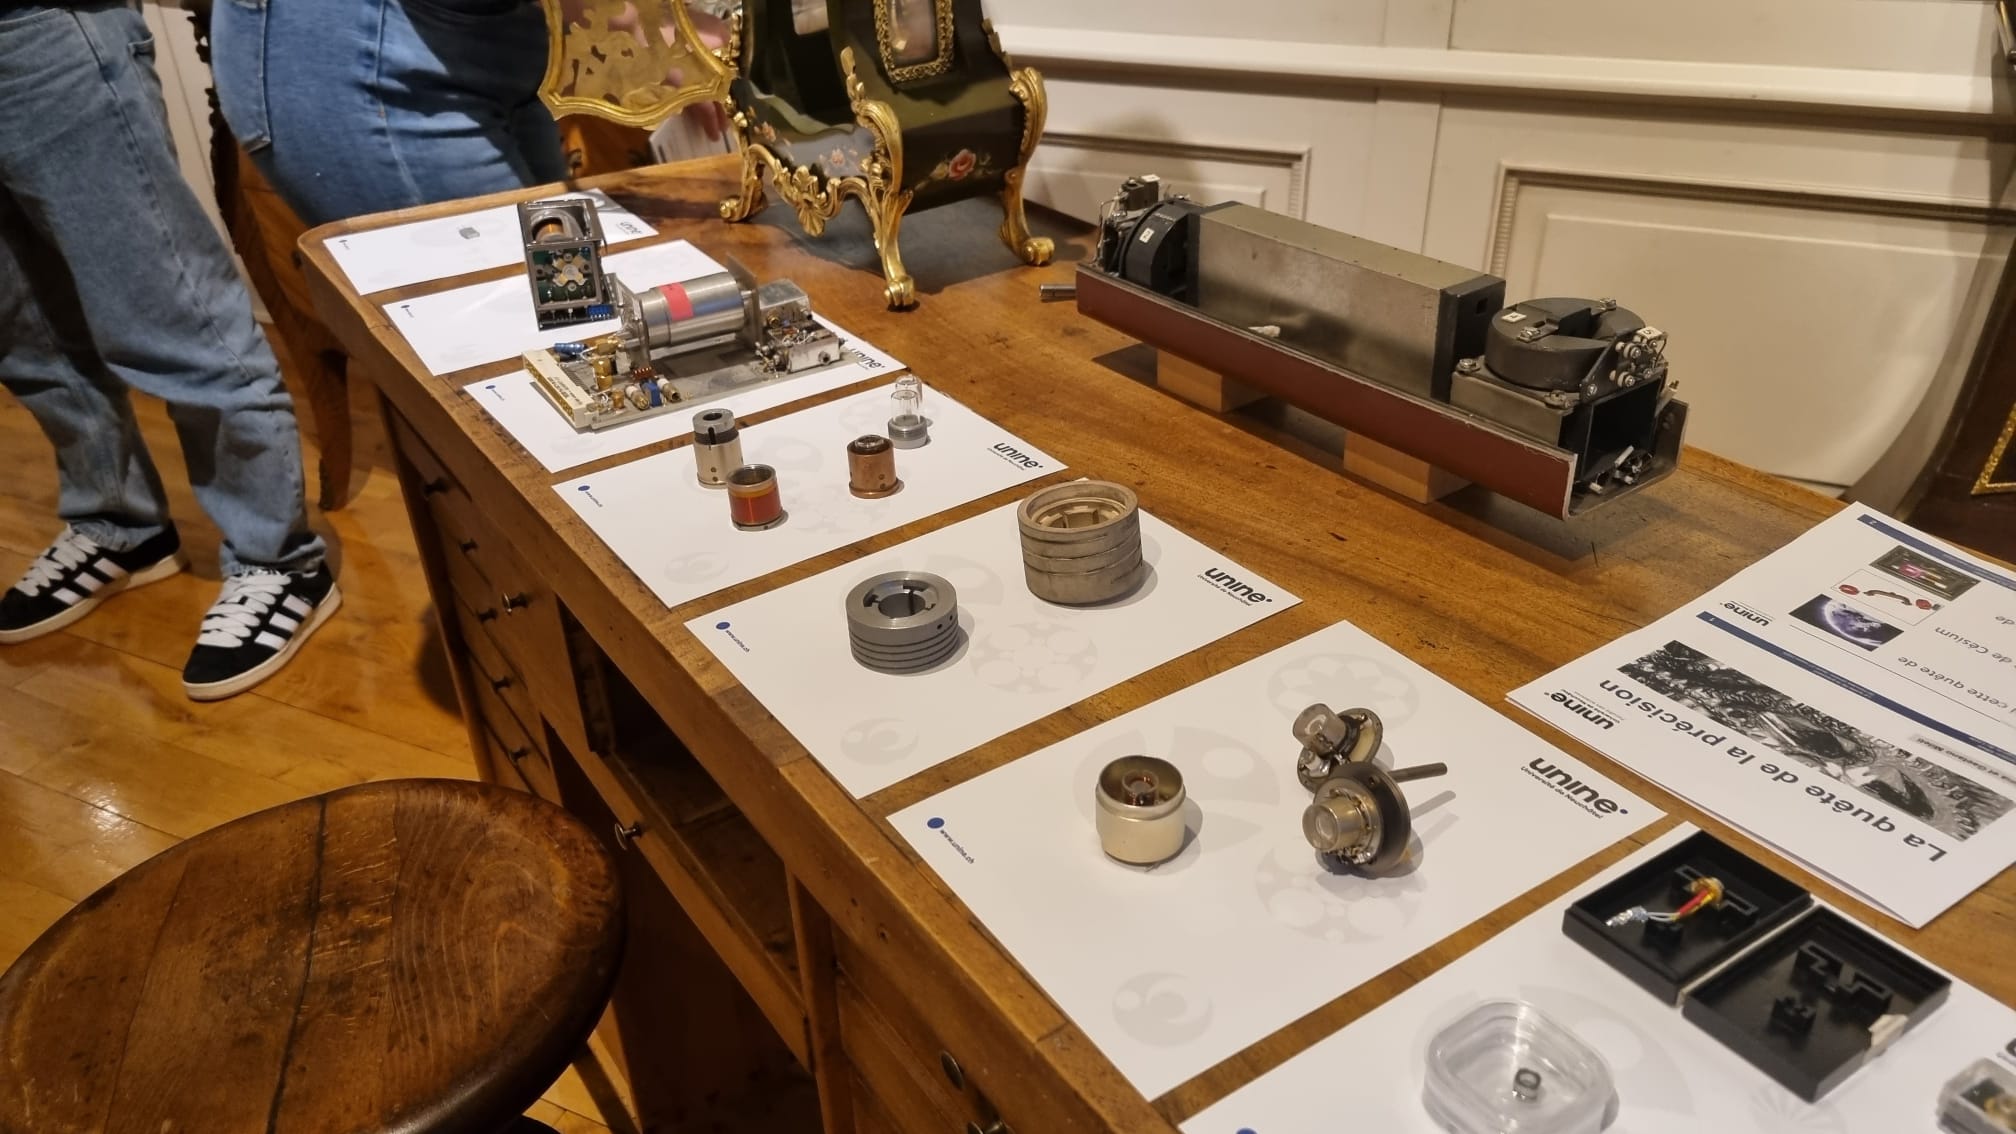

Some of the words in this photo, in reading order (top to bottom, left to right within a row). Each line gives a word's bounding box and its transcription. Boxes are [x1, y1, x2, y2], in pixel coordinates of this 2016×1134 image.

[993, 442, 1039, 468] unine
[1204, 567, 1266, 603] unine
[1724, 602, 1770, 627] unine
[1935, 626, 1989, 655] Césium
[1898, 656, 1918, 667] de
[1992, 652, 2013, 664] de
[1920, 666, 1965, 689] quête
[1550, 691, 1614, 730] unine
[1967, 688, 2008, 709] cette
[1600, 679, 1728, 747] précision
[1727, 746, 1756, 765] la
[1528, 757, 1619, 814] unine
[1760, 762, 1800, 784] de
[1805, 785, 1896, 833] quête
[1903, 833, 1948, 863] La
